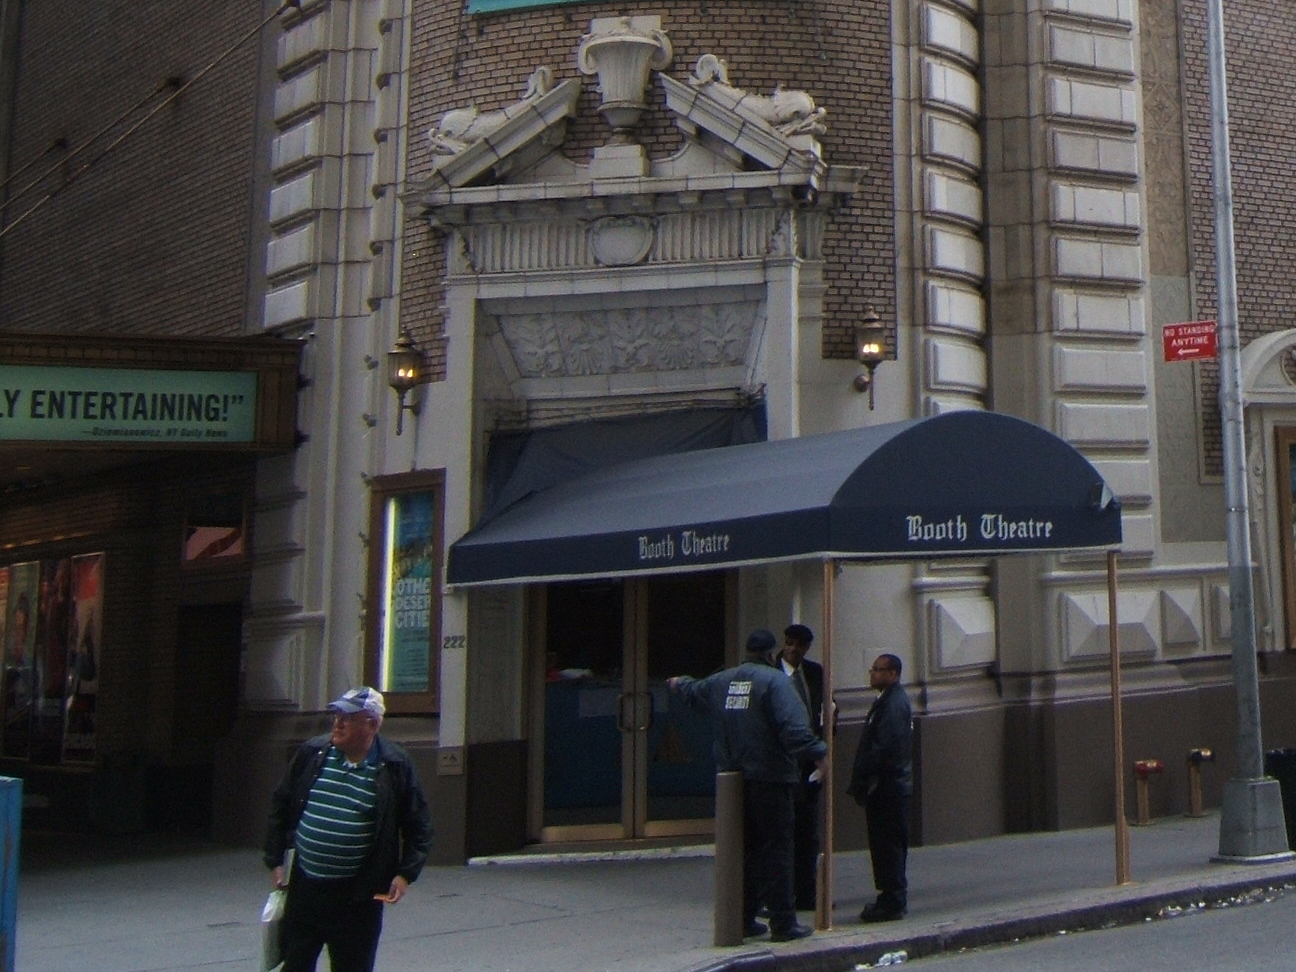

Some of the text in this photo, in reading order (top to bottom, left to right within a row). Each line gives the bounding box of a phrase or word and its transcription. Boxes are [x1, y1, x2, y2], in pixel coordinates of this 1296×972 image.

[1165, 325, 1216, 336] NO STANDING
[1171, 336, 1208, 347] ANYTIME
[0, 389, 21, 419] Y
[906, 513, 1054, 542] Booth Theatre
[638, 531, 729, 559] Booth Theatre
[396, 577, 431, 595] OTHE
[396, 610, 430, 629] CITIE
[443, 636, 465, 649] 222
